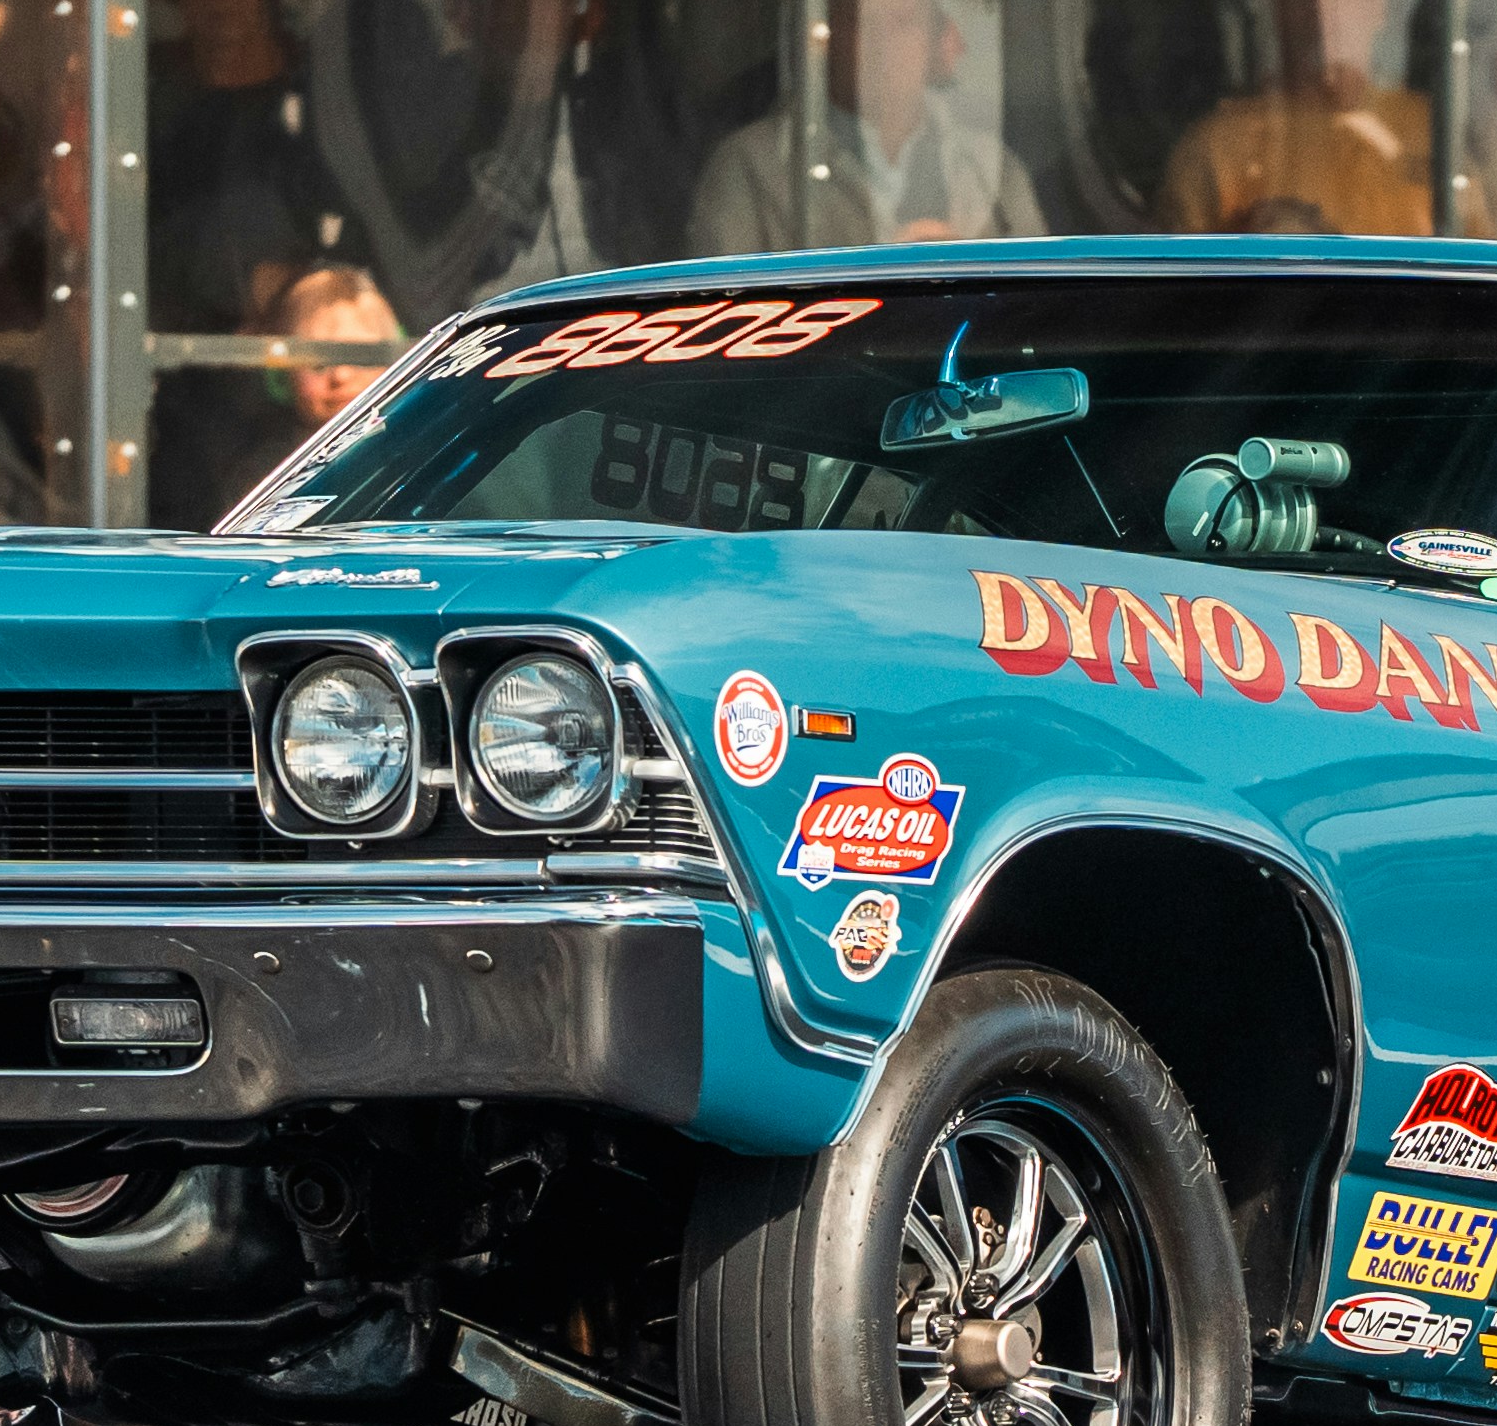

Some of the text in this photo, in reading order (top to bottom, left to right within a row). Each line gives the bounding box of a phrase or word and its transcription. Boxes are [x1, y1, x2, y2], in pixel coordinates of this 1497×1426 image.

[484, 299, 883, 378] 8608
[1418, 541, 1493, 557] GAINESVILLE
[970, 570, 1280, 695] DYNO
[724, 701, 780, 729] Williams
[736, 723, 767, 743] Bros
[889, 767, 931, 798] NHRA
[808, 803, 938, 845] LUCAS OIL
[841, 842, 927, 861] Drag Racing
[856, 856, 901, 870] Series
[1365, 1255, 1481, 1294] RACING CAMS
